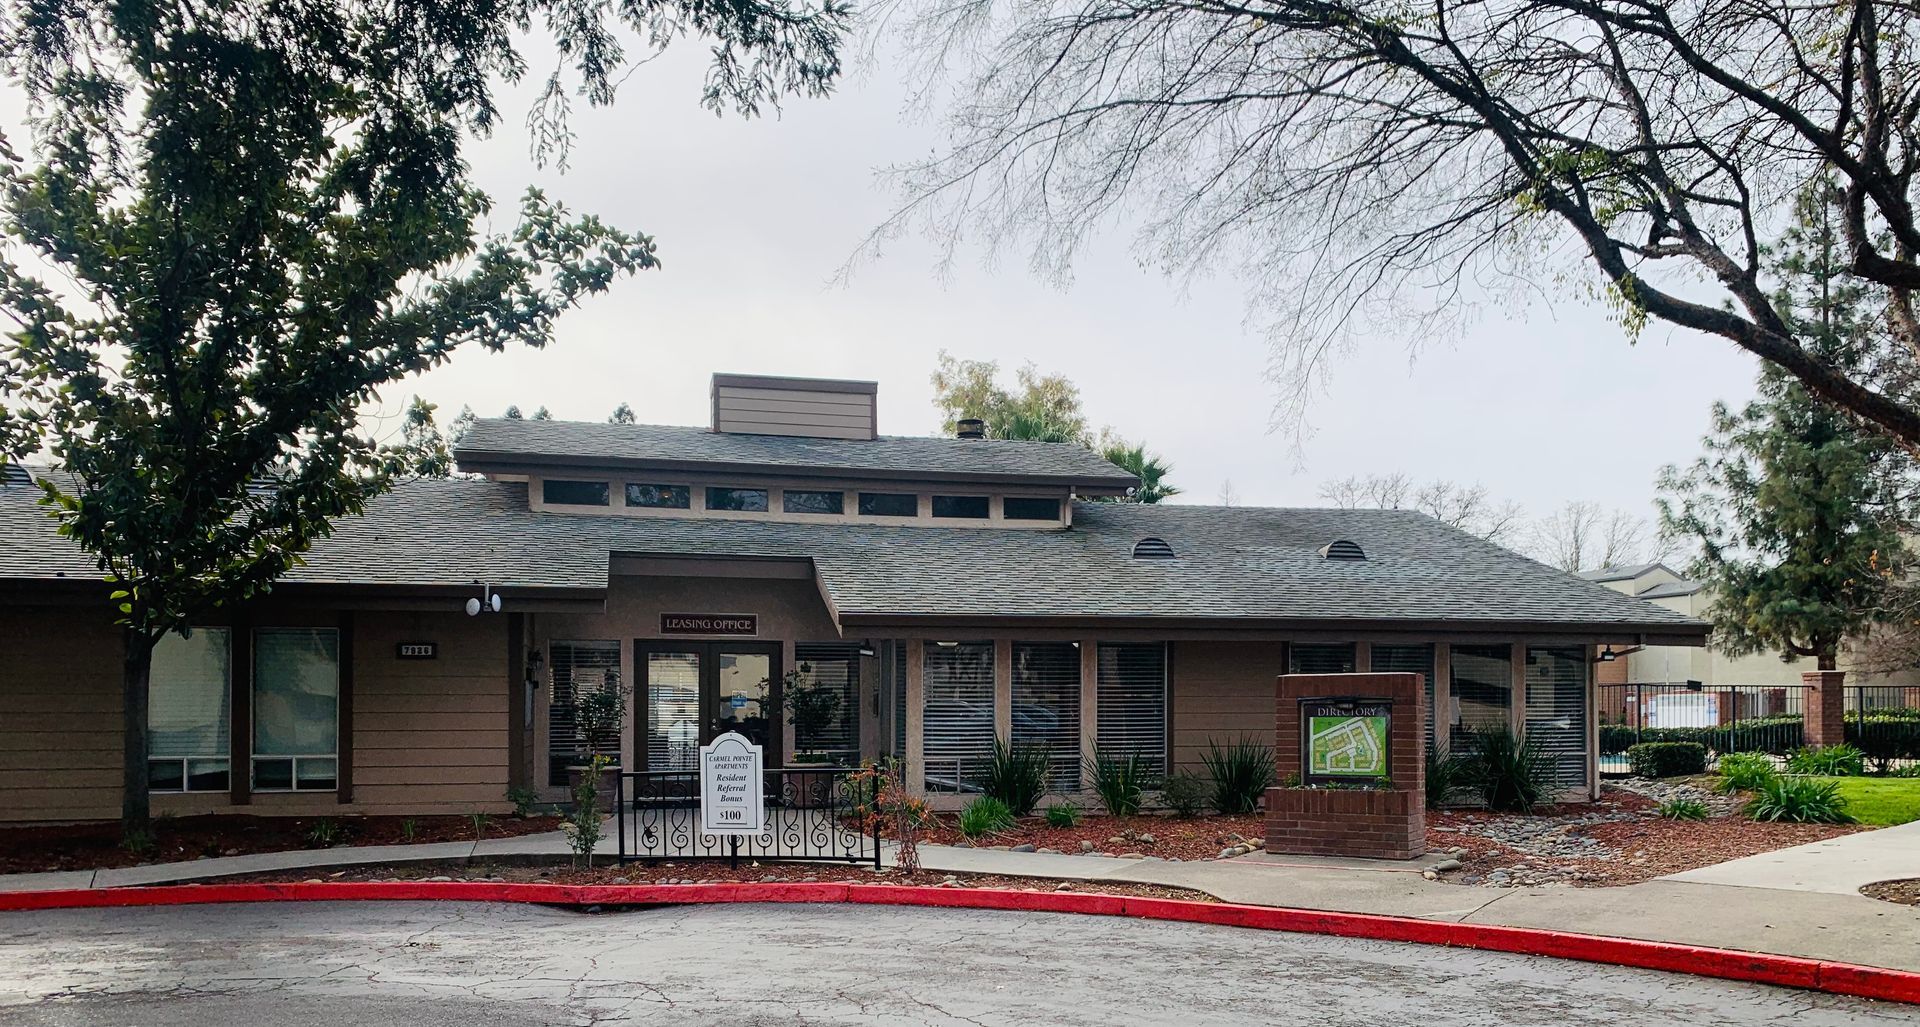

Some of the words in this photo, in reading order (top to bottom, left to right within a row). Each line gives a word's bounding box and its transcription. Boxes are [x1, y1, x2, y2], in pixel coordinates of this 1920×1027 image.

[666, 619, 711, 628] LEASING
[713, 620, 752, 629] OFFICE
[1317, 707, 1377, 716] DIRECTORY
[716, 774, 747, 782] Resident
[717, 784, 746, 793] Referral
[720, 810, 741, 820] $100
